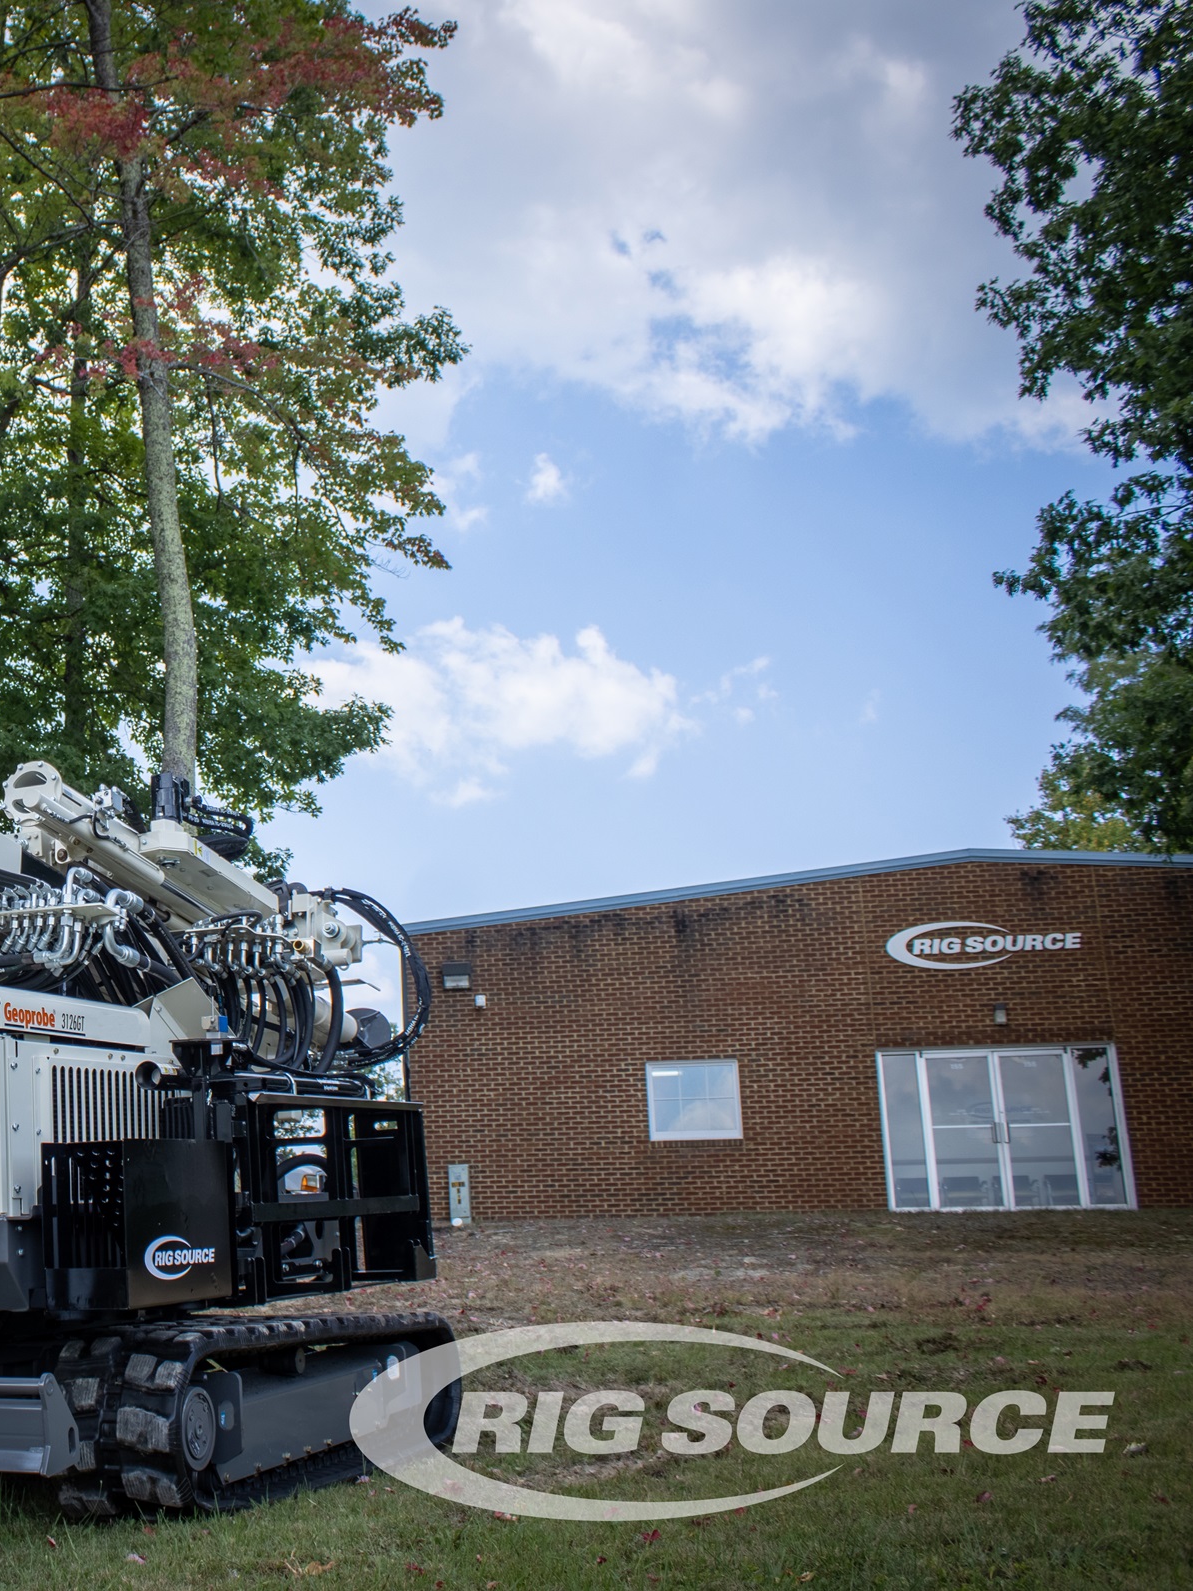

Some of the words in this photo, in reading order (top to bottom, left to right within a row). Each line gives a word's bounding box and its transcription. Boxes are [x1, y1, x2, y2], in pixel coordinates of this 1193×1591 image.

[912, 937, 962, 955] RIG
[964, 932, 1082, 953] SOURCE
[4, 1002, 56, 1029] Geoprobe
[61, 1013, 85, 1032] 3126GT
[154, 1250, 174, 1266] RIG
[174, 1247, 215, 1265] SOURCE
